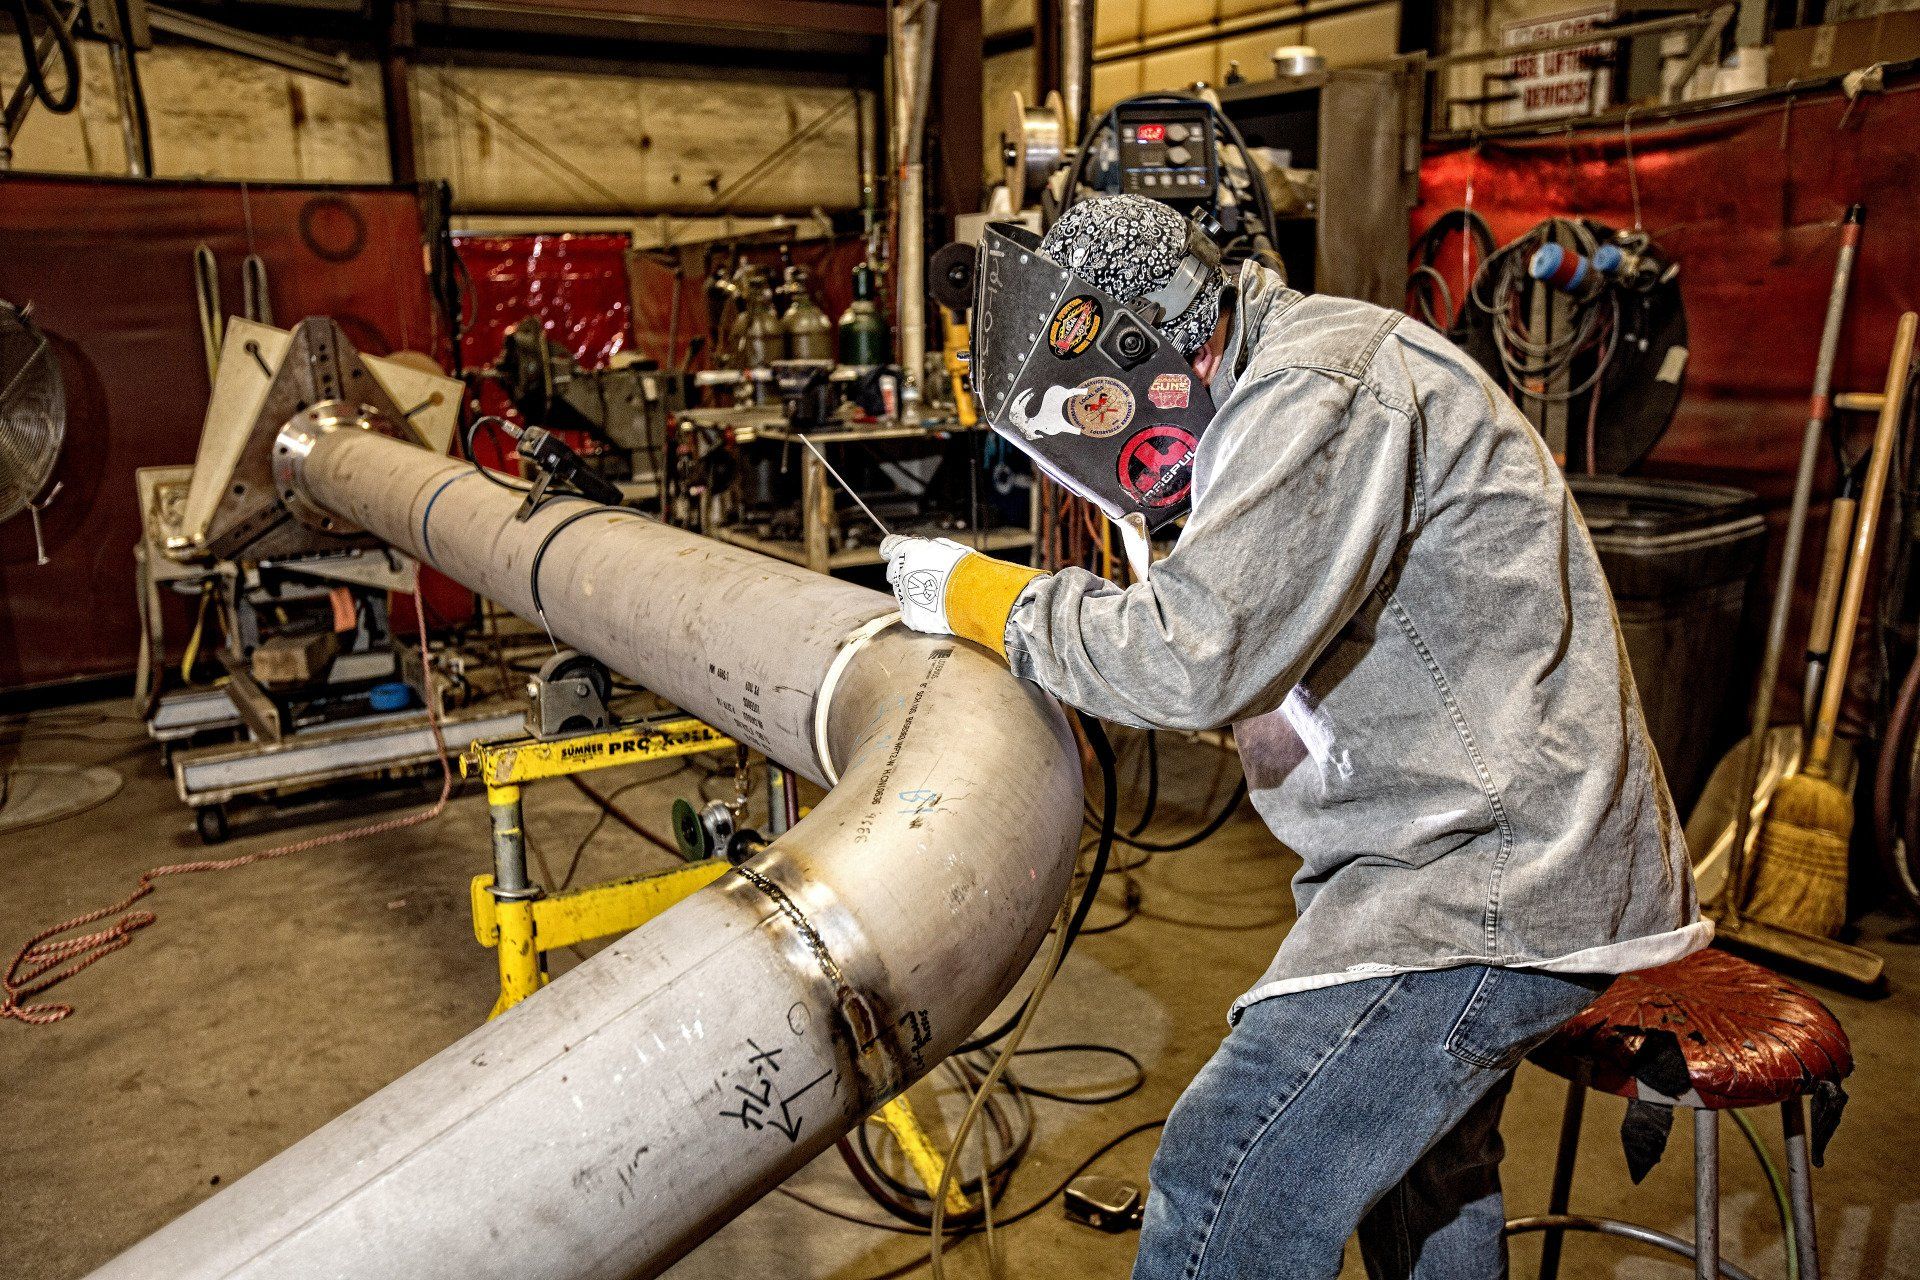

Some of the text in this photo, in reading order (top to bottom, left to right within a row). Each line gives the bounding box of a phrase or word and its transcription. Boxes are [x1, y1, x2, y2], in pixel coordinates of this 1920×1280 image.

[1150, 382, 1188, 391] GUNS
[1078, 391, 1094, 405] LOCAL
[561, 743, 604, 760] SUMNER
[609, 738, 650, 755] PRO
[719, 1037, 783, 1131] X-74
